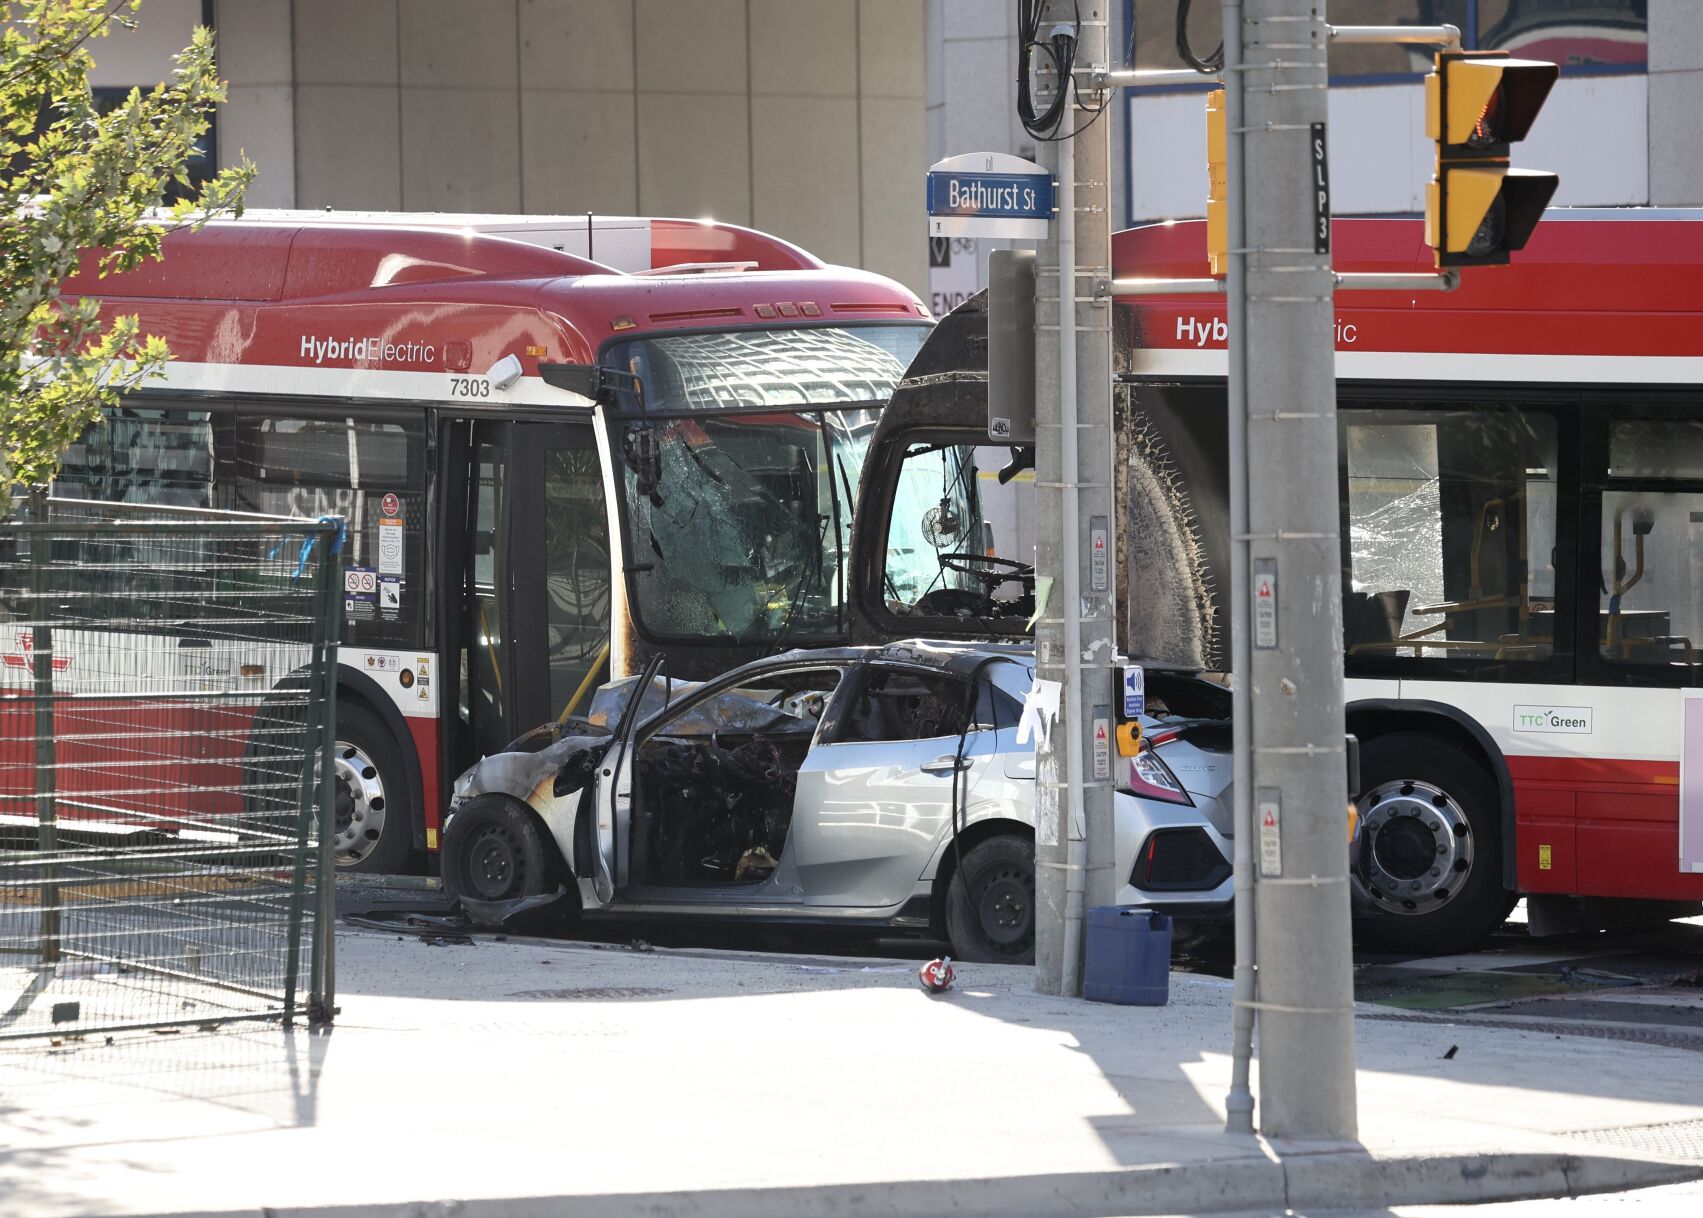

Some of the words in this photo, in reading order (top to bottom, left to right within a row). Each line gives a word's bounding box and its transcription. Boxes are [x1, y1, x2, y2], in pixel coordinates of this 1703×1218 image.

[950, 179, 1019, 210] Bathurst
[1023, 187, 1036, 210] St
[300, 335, 435, 363] HybridElectric
[450, 378, 490, 397] 7303
[205, 665, 231, 676] Green
[1519, 715, 1544, 726] TTC
[1550, 715, 1586, 728] Green
